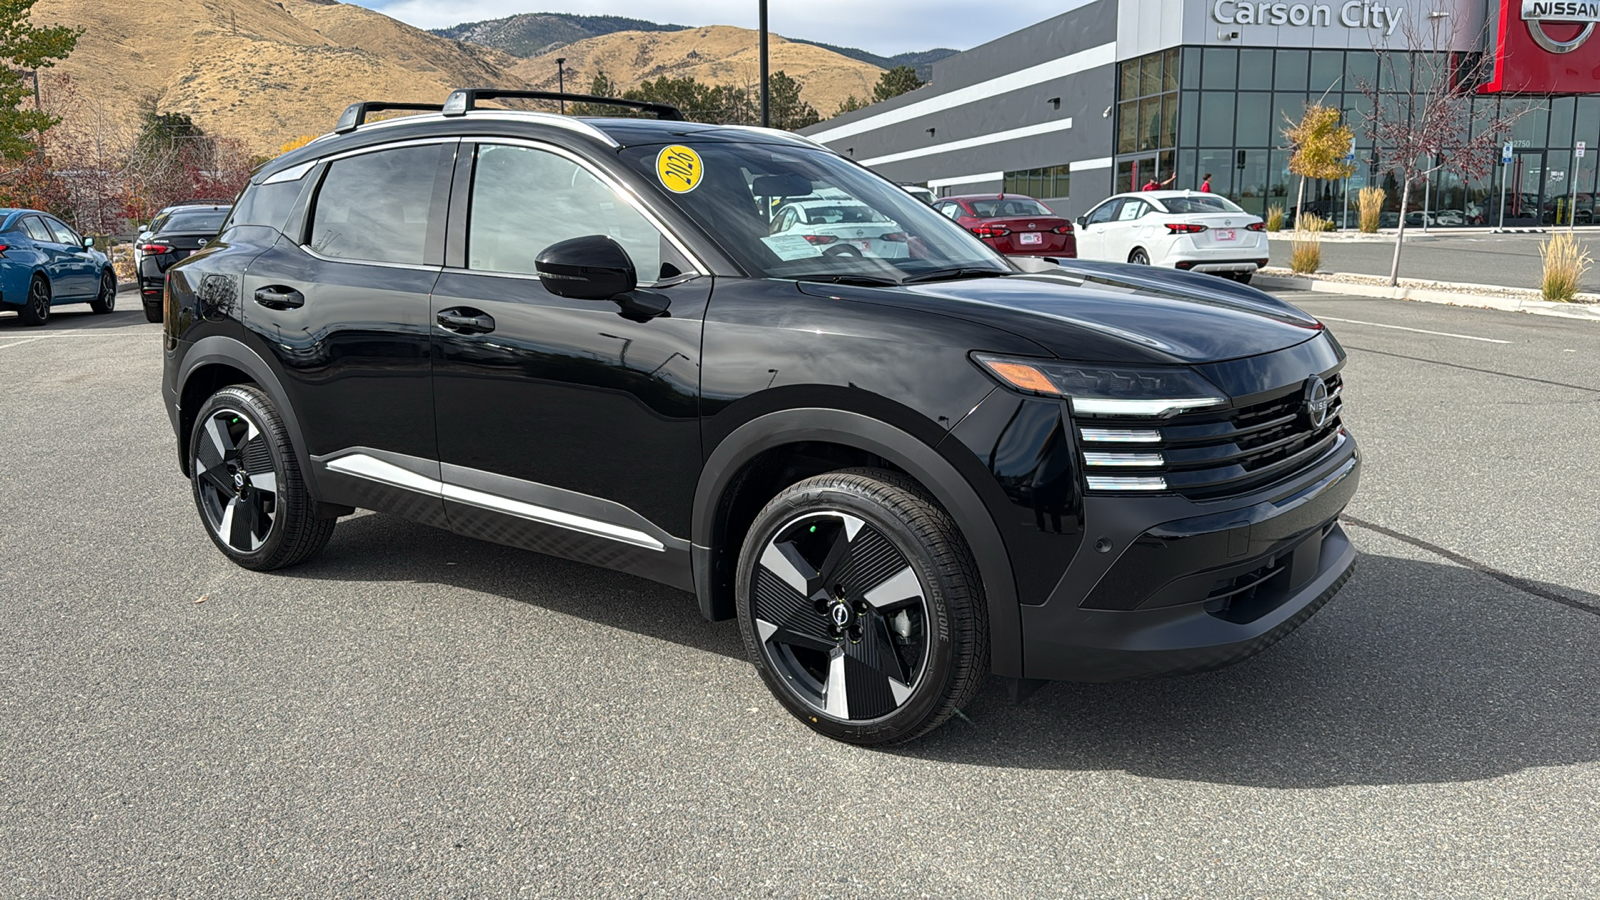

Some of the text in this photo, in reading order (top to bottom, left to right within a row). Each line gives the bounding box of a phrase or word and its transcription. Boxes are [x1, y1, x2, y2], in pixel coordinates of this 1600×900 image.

[1213, 0, 1404, 36] Carson City
[1532, 2, 1599, 17] NISSAN
[1513, 140, 1531, 148] 2750
[664, 148, 695, 186] 2026
[1309, 401, 1327, 411] NISS
[917, 557, 949, 643] BRIDGESTONE
